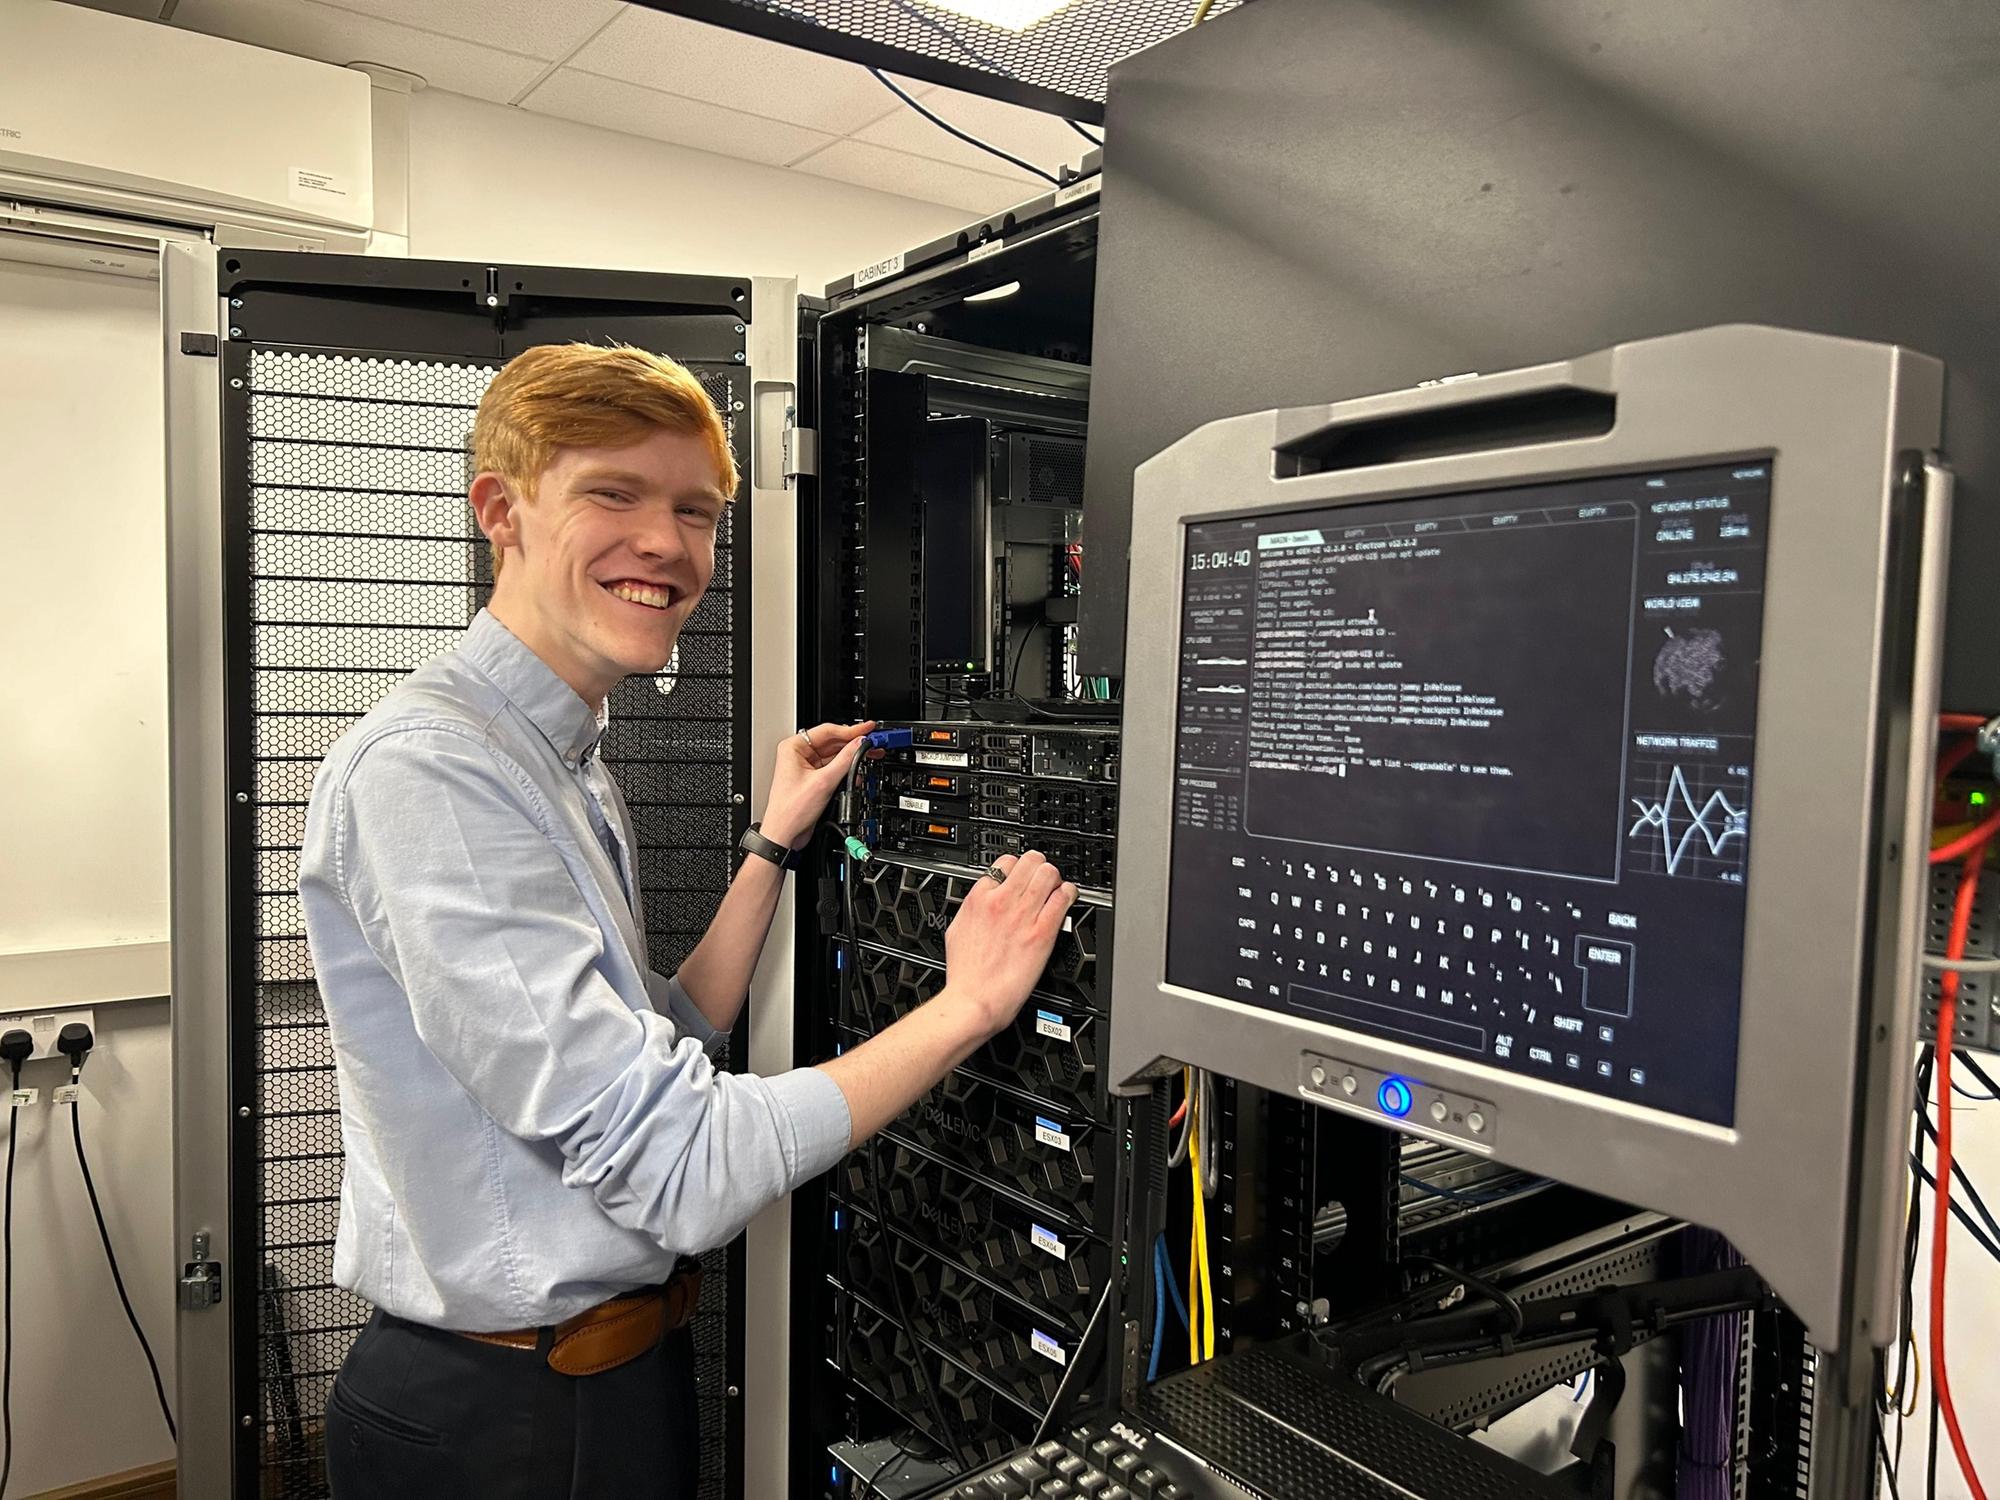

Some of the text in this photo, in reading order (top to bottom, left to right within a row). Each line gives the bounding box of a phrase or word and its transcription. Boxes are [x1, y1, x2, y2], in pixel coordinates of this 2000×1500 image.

[0, 128, 21, 138] TRIC
[859, 256, 898, 282] CABINET 3
[1651, 497, 1729, 513] NETWORK STATUS
[1579, 508, 1607, 518] EMPTY
[1415, 522, 1438, 532] EMPTY
[1492, 516, 1518, 526] EMPTY
[1656, 529, 1695, 542] ONLINE
[1356, 542, 1385, 550] Electron
[1192, 550, 1250, 570] 15:04:40
[1416, 549, 1440, 558] update
[1644, 598, 1700, 609] WORLD VIEW
[1424, 683, 1462, 691] InRelease
[1456, 696, 1496, 704] InRelease
[1464, 708, 1504, 716] InRelease
[1450, 718, 1490, 727] InRelease
[1636, 736, 1718, 749] NETWORK TRAFFIC
[1384, 758, 1400, 768] list
[1460, 764, 1469, 773] to
[1473, 766, 1487, 774] see
[1490, 766, 1513, 776] them.
[904, 800, 924, 809] TENABLE
[1232, 856, 1246, 868] ESC
[1286, 864, 1293, 876] 1
[1307, 866, 1316, 879] 2
[1330, 870, 1339, 883] 3
[1353, 874, 1362, 887] 4
[1378, 878, 1387, 891] 5
[1402, 881, 1412, 895] 6
[1428, 884, 1438, 898] 7
[1608, 912, 1637, 929] BACK
[1238, 887, 1252, 899] TAB
[1271, 892, 1280, 906] Q
[1291, 896, 1302, 908] W
[1314, 900, 1323, 912] E
[1338, 903, 1346, 916] R
[1361, 907, 1370, 920] T
[1386, 911, 1395, 925] Y
[1410, 916, 1421, 930] U
[1438, 920, 1446, 935] I
[1491, 928, 1502, 944] P
[1238, 918, 1476, 976] CAPS A S D F G H J K L
[1588, 946, 1622, 965] ENTER
[1236, 977, 1280, 996] CTRL FN
[1240, 948, 1260, 960] SHIFT
[1319, 964, 1328, 977] X
[1342, 969, 1351, 982] C
[1366, 974, 1376, 987] V
[1390, 979, 1400, 993] B
[1416, 984, 1426, 999] N
[1441, 990, 1454, 1005] M
[1554, 1015, 1584, 1033] SHIFT
[1043, 1024, 1063, 1037] ESX02
[1496, 1034, 1513, 1048] ALT
[1496, 1046, 1552, 1064] GR CTRL
[1042, 1130, 1062, 1145] ESX03
[1224, 1140, 1233, 1151] 27
[1224, 1204, 1233, 1214] 26
[1038, 1236, 1057, 1253] ESX04
[1282, 1258, 1292, 1269] 25
[1222, 1266, 1232, 1277] 25
[1281, 1318, 1291, 1329] 24
[1222, 1328, 1231, 1339] 24
[1038, 1341, 1057, 1358] ESX05
[1110, 1422, 1148, 1450] DELL
